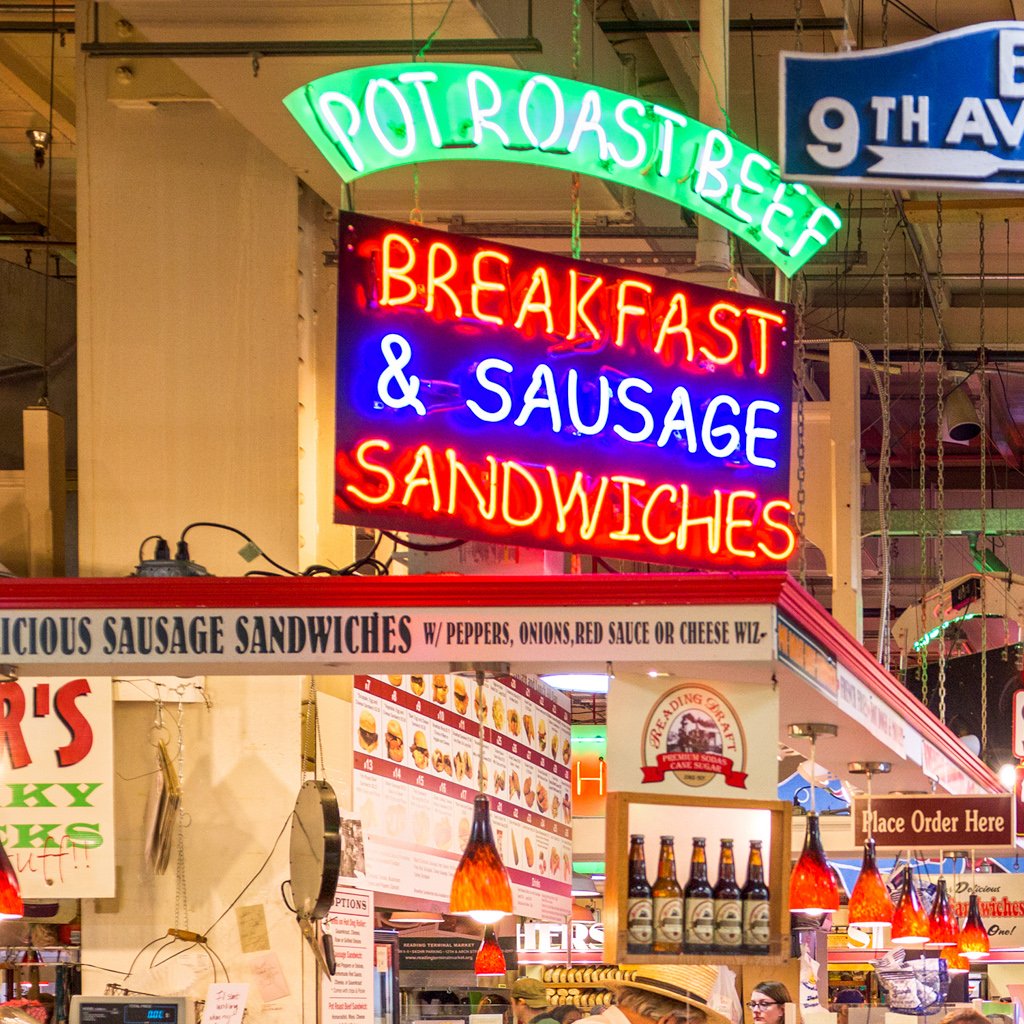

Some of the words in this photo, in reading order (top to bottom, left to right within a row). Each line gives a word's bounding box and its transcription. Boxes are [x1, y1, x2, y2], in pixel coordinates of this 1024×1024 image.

[805, 95, 930, 170] 9TH
[317, 71, 445, 173] POT
[467, 69, 687, 177] ROAST
[695, 130, 843, 258] BEEF
[378, 232, 786, 376] BREAKFAST
[376, 333, 427, 416] &
[465, 358, 781, 470] SAUSAGE
[346, 439, 796, 562] SANDWICHES
[102, 615, 225, 656] SAUSAGE
[234, 612, 413, 655] SANDWICHES
[423, 621, 442, 648] W/
[446, 621, 514, 648] PEPPERS,
[608, 621, 650, 645] SAUCE
[654, 621, 675, 645] OR
[680, 621, 730, 645] CHEESE
[650, 693, 702, 750] READING
[704, 697, 737, 752] DRAFT
[0, 782, 104, 808] KY
[0, 822, 104, 850] KS
[861, 810, 906, 834] Place
[911, 809, 959, 834] Order
[964, 809, 1005, 833] Here
[8, 835, 90, 884] uff!!
[333, 897, 367, 911] PTIONS
[988, 924, 1017, 937] One!
